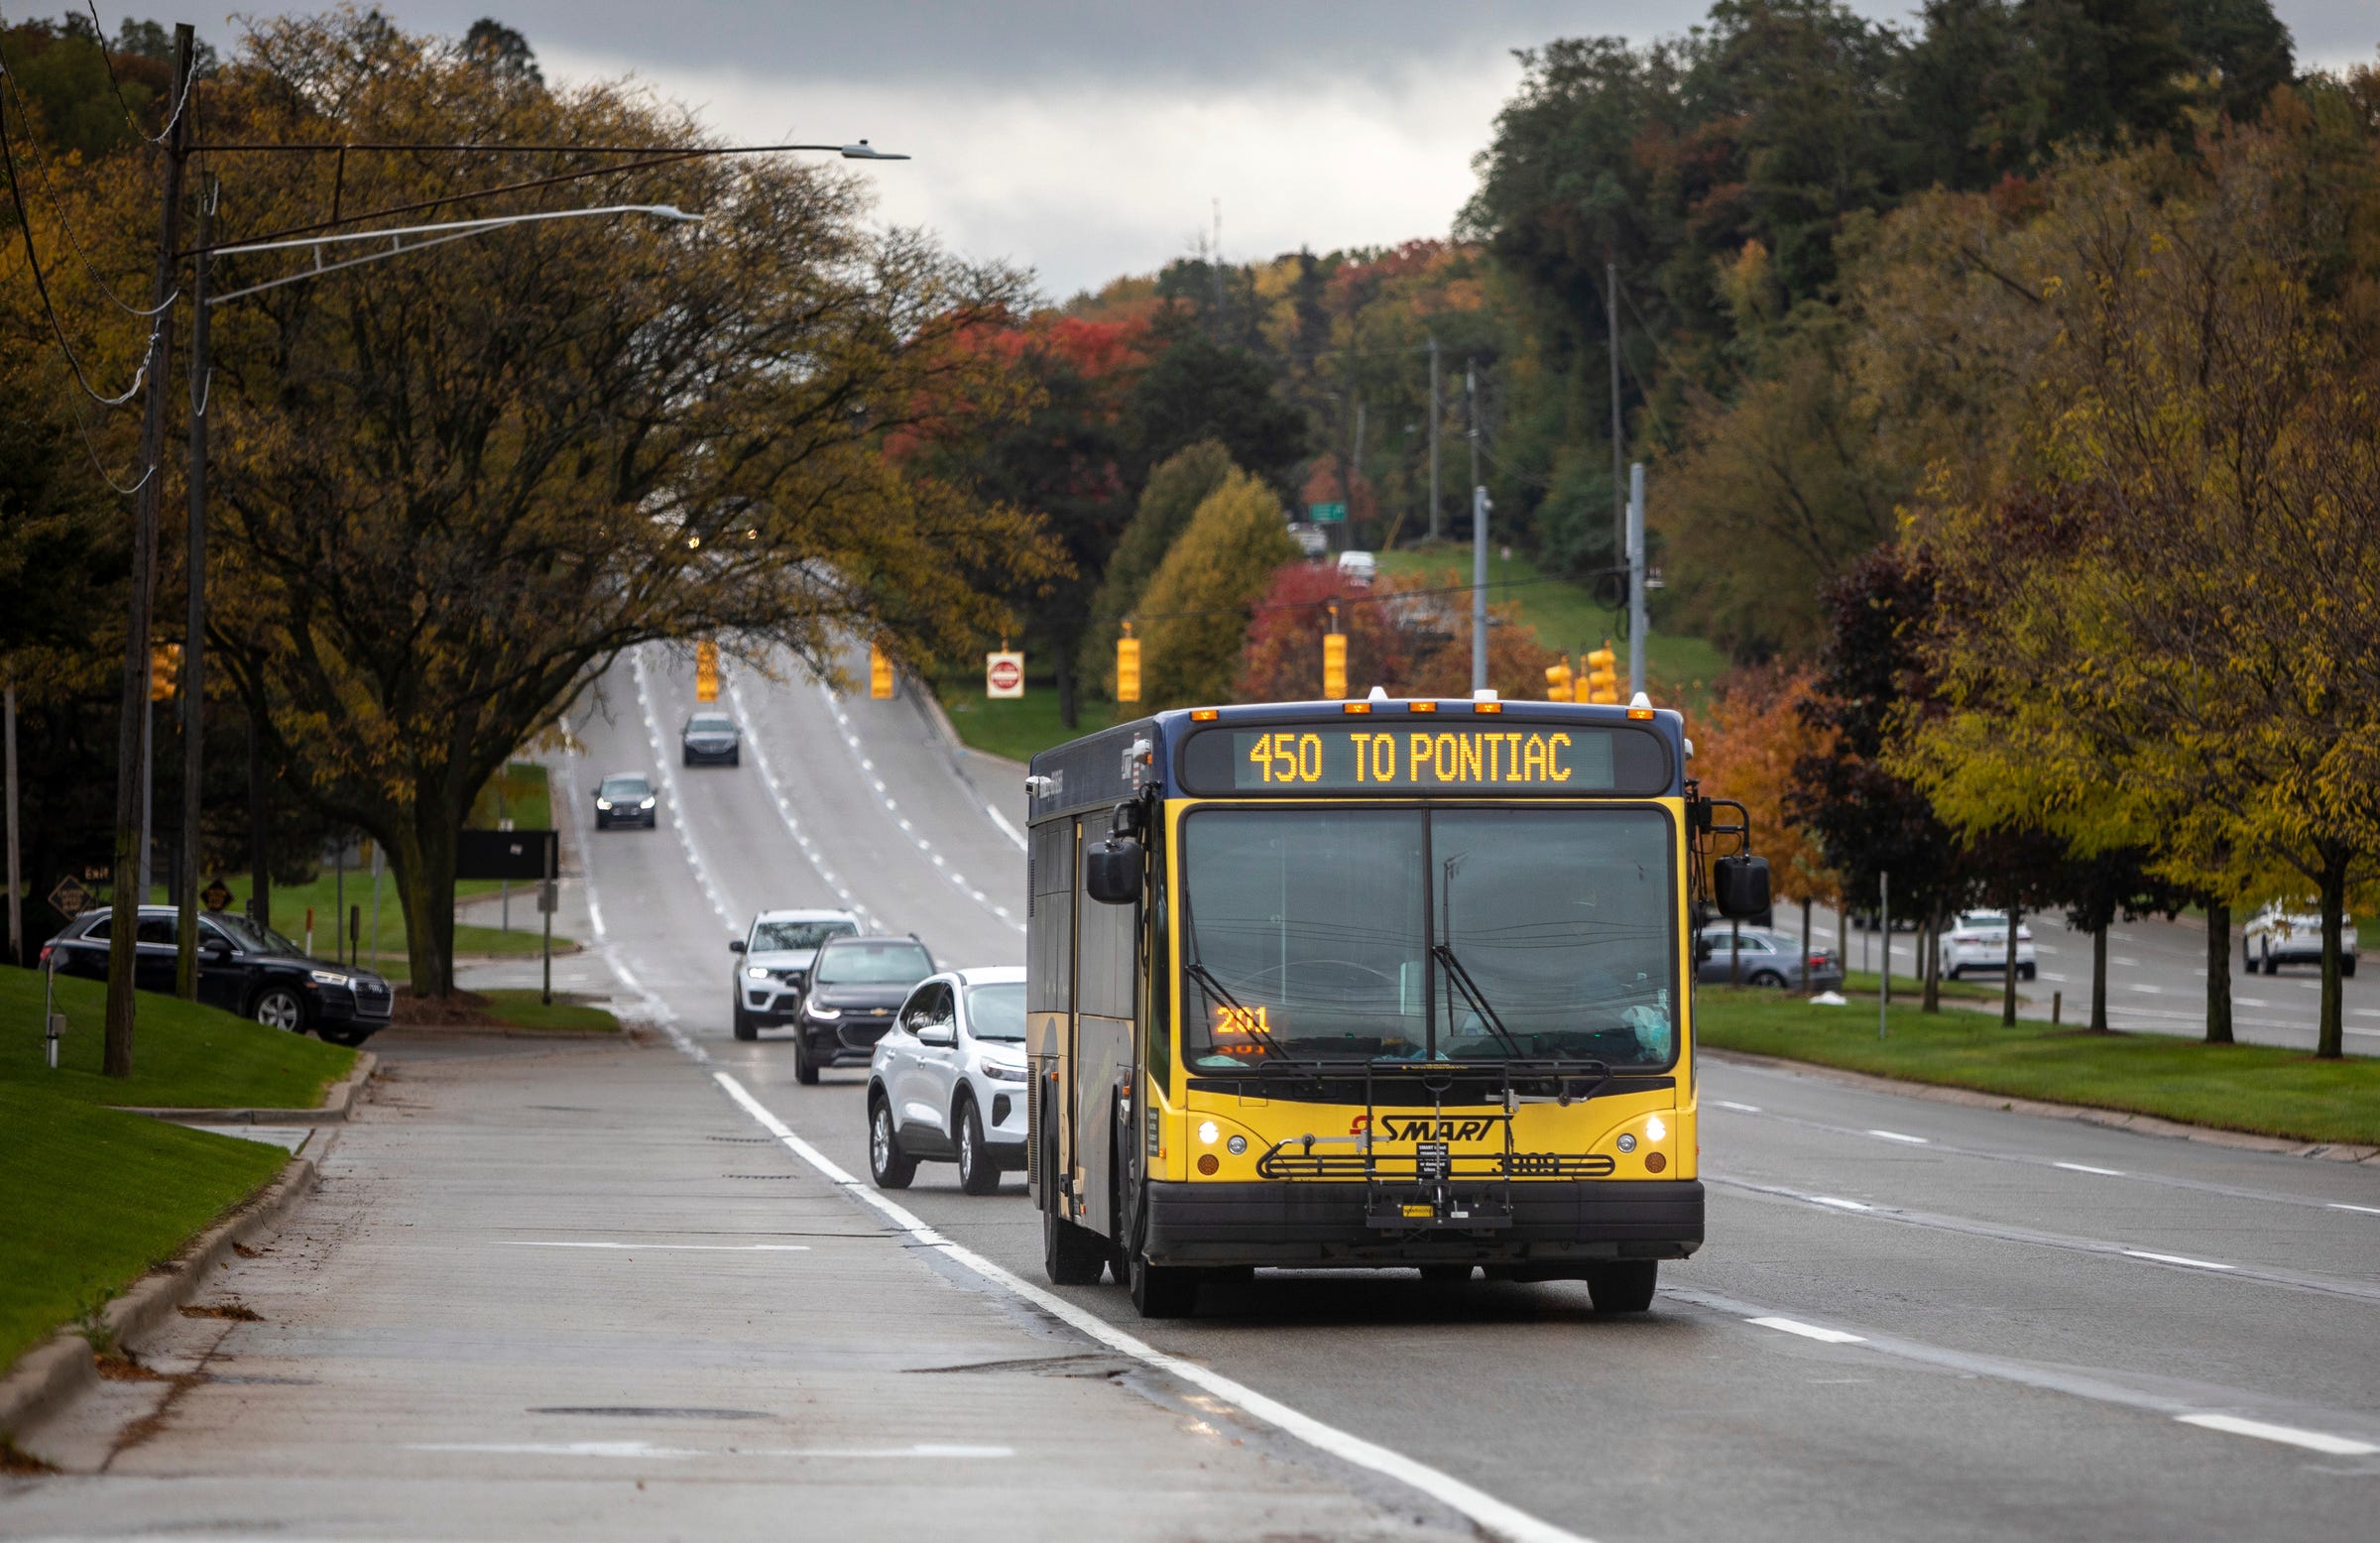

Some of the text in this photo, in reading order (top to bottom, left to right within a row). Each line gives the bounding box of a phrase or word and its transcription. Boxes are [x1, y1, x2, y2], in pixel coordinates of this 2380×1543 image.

[1250, 733, 1572, 781] 450 TO PONTIAC
[1216, 1006, 1270, 1033] 201
[1380, 1115, 1515, 1141] SMART
